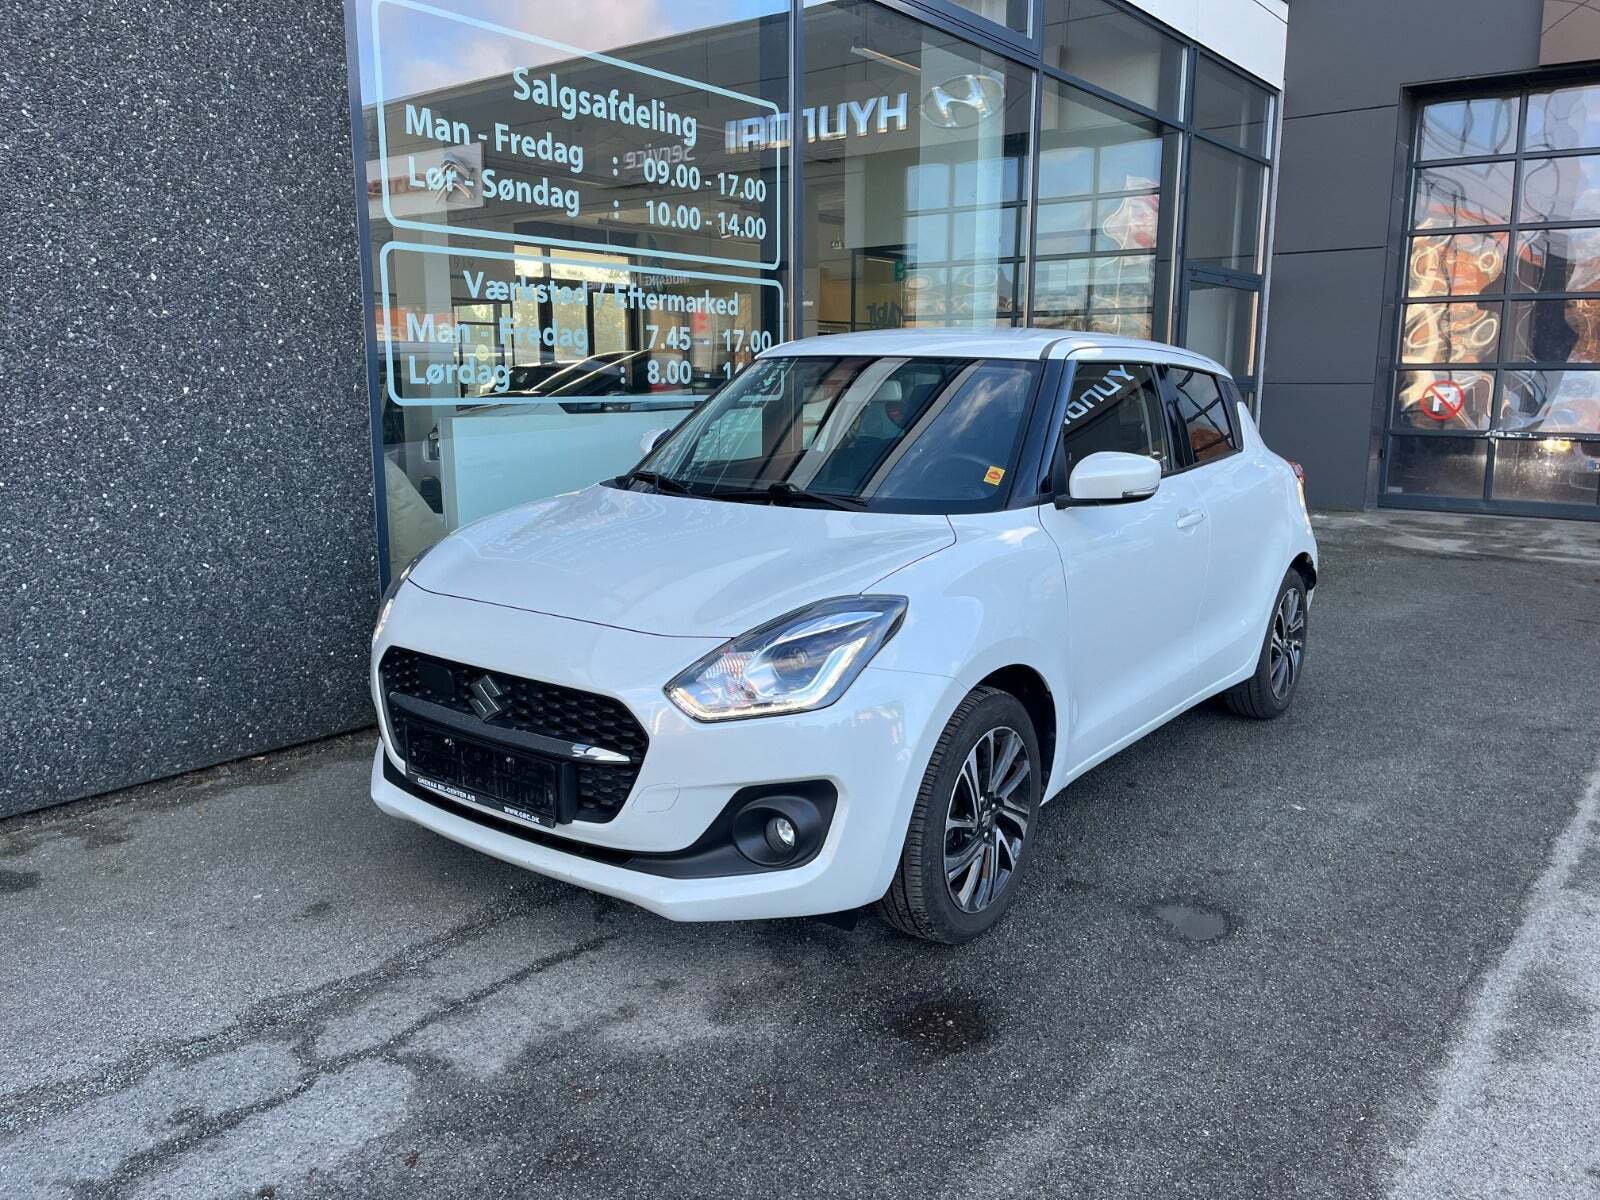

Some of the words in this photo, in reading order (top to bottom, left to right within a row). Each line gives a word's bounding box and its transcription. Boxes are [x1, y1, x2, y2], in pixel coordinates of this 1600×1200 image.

[513, 66, 697, 146] Salgsafdeling
[405, 104, 470, 145] Man
[495, 122, 584, 174] Fredag
[643, 157, 700, 191] 09.00
[717, 172, 767, 202] 17.00
[408, 156, 457, 192] Lør
[481, 168, 580, 218] Søndag
[646, 200, 700, 231] 10.00
[718, 211, 767, 240] 14.00
[463, 271, 588, 306] Værksted
[614, 284, 739, 316] Eftermarked
[406, 312, 471, 344] Man
[500, 316, 589, 356] Fredag
[646, 325, 692, 350] 7.45
[723, 328, 772, 353] 17.00
[409, 355, 510, 393] Lørdag
[647, 359, 692, 385] 8.00
